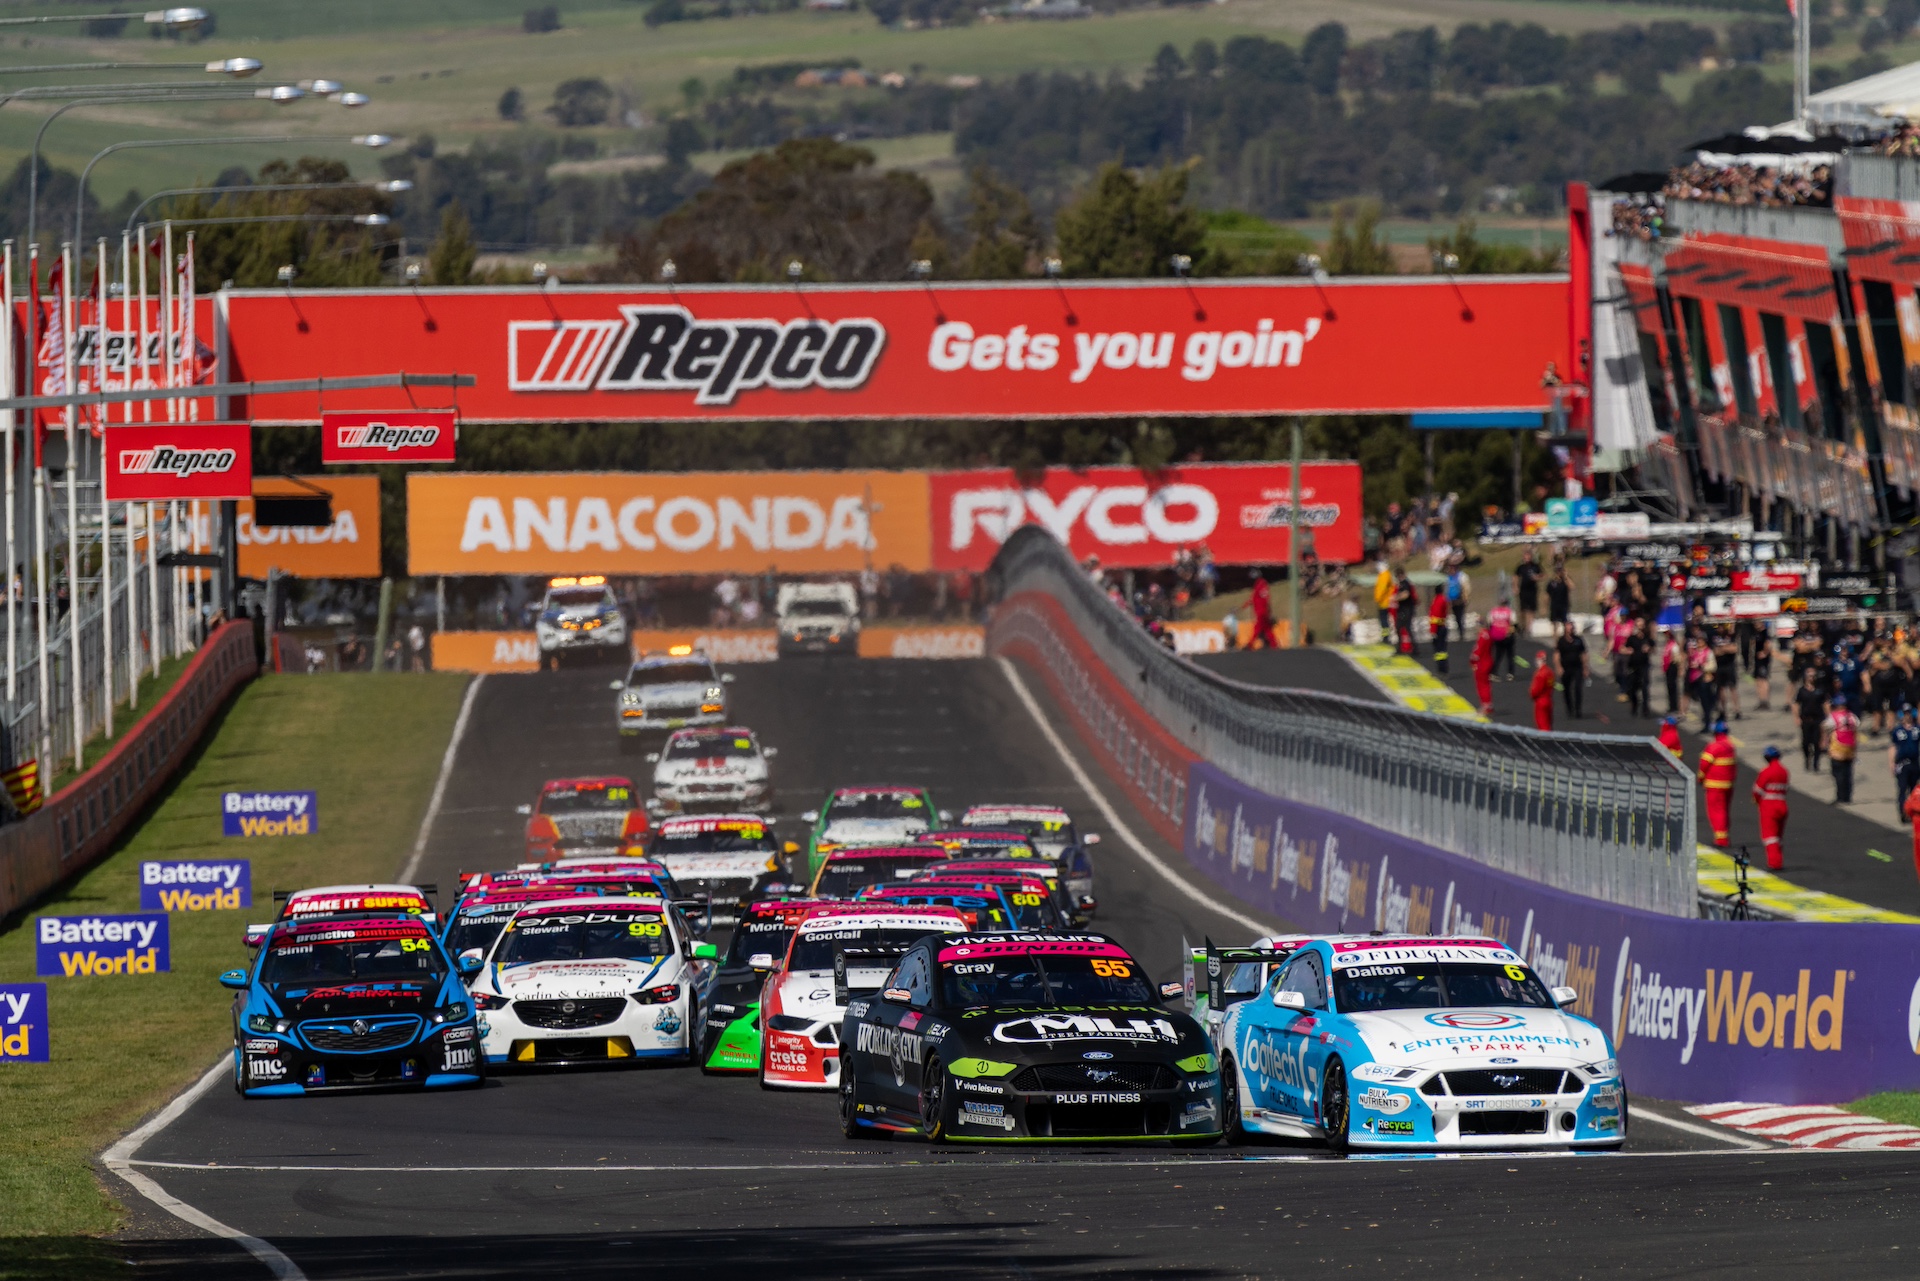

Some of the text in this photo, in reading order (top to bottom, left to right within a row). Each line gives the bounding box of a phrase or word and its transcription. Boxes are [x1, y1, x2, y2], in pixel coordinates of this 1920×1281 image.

[596, 304, 887, 404] Repco
[928, 321, 1060, 372] Gets
[1070, 332, 1175, 382] you
[363, 423, 440, 451] Repco
[150, 445, 236, 477] Repco
[461, 495, 877, 553] ANACONDA
[951, 484, 1219, 551] RYCO
[225, 793, 309, 815] Battery
[239, 815, 309, 836] World
[143, 862, 241, 889] Battery
[159, 888, 241, 911] World
[292, 897, 420, 913] MAKE IT SUPER
[522, 923, 662, 937] Stewart 99
[848, 918, 963, 927] PLASTERERS
[40, 918, 158, 948] Battery
[805, 930, 862, 942] Goodall
[945, 934, 1106, 947] viva leisure
[277, 939, 431, 957] Sinni 54
[980, 944, 1105, 953] DUNLOP
[1369, 949, 1488, 962] FIDUCIAN
[59, 948, 157, 976] World
[954, 959, 1131, 978] Gray 55
[1346, 964, 1526, 982] Dalton 6
[514, 988, 626, 1001] Carlin & Gazzard
[1629, 963, 1847, 1065] Battery World
[857, 1022, 923, 1065] WORLD GYM
[1041, 1031, 1084, 1040] STEEL
[1403, 1034, 1581, 1053] ENTERTAINMENT
[1470, 1044, 1527, 1052] PARK
[770, 1051, 807, 1065] crete
[1242, 1026, 1300, 1092] logitech
[776, 1064, 796, 1072] works
[963, 1082, 978, 1091] viva
[978, 1082, 1004, 1094] leisure
[1369, 1088, 1388, 1099] BULK
[1056, 1093, 1141, 1104] PLUS FITNESS
[1359, 1095, 1399, 1108] NUTRIENTS
[964, 1114, 1005, 1126] FASTENERS
[1377, 1119, 1415, 1132] Recycal
